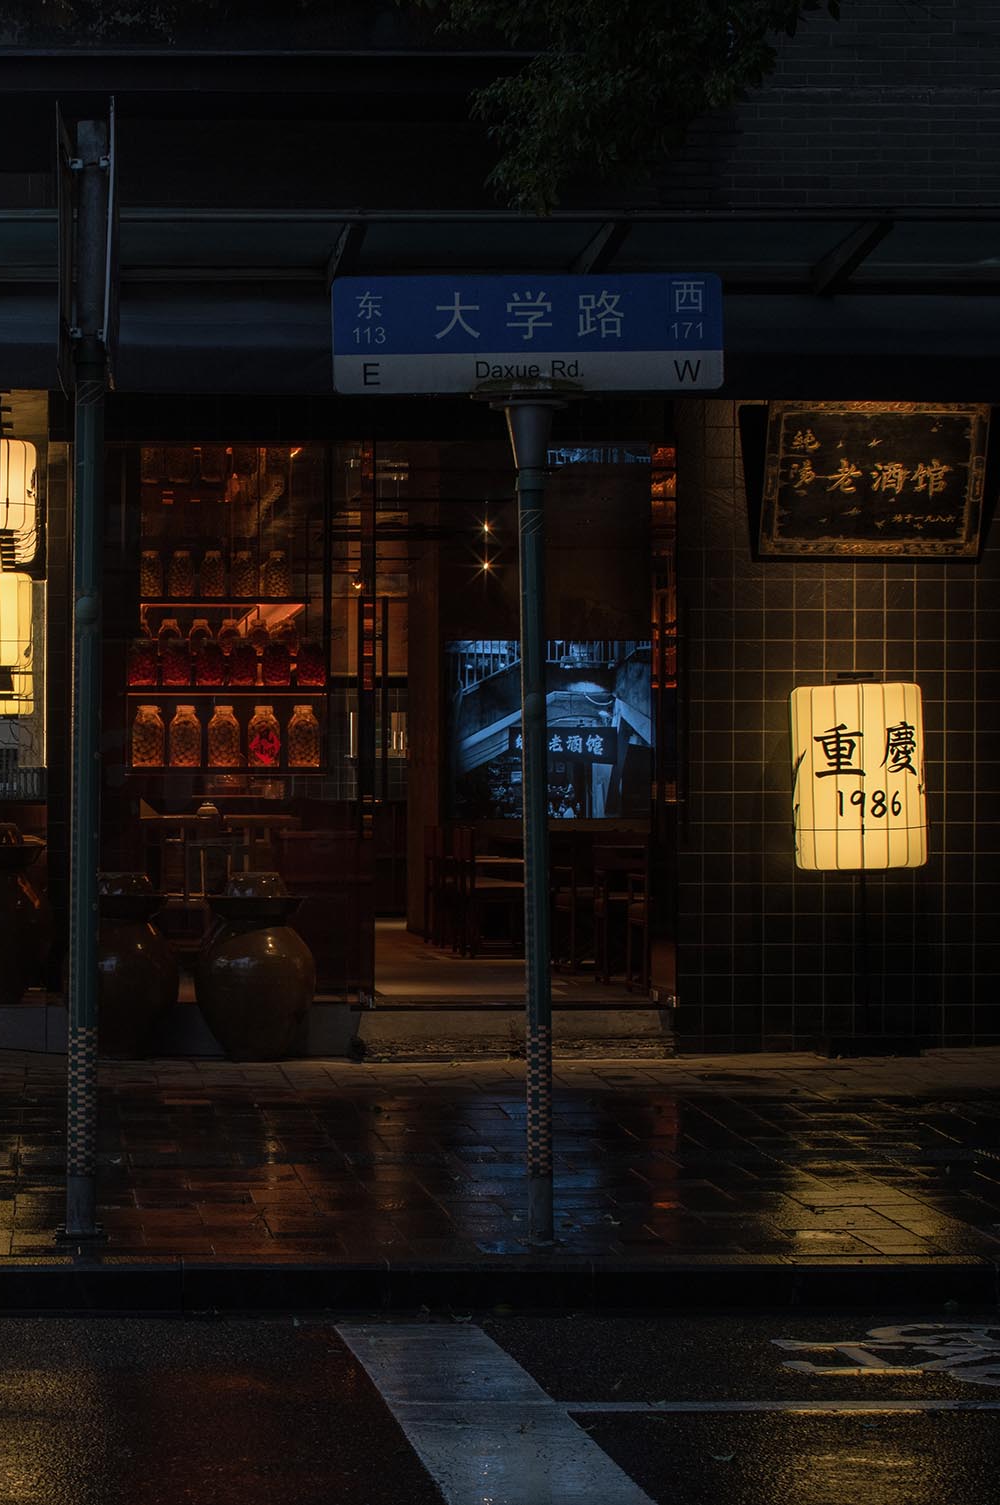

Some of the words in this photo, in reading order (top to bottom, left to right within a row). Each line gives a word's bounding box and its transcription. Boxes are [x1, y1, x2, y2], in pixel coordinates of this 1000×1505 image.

[355, 291, 384, 320] 东
[671, 281, 705, 314] 西
[434, 289, 626, 341] 大学路
[352, 327, 387, 345] 113
[670, 322, 705, 340] 171
[362, 362, 381, 386] E
[475, 360, 541, 380] Daxue
[551, 359, 585, 378] Rd.
[673, 359, 702, 383] W
[836, 789, 903, 819] 1986
